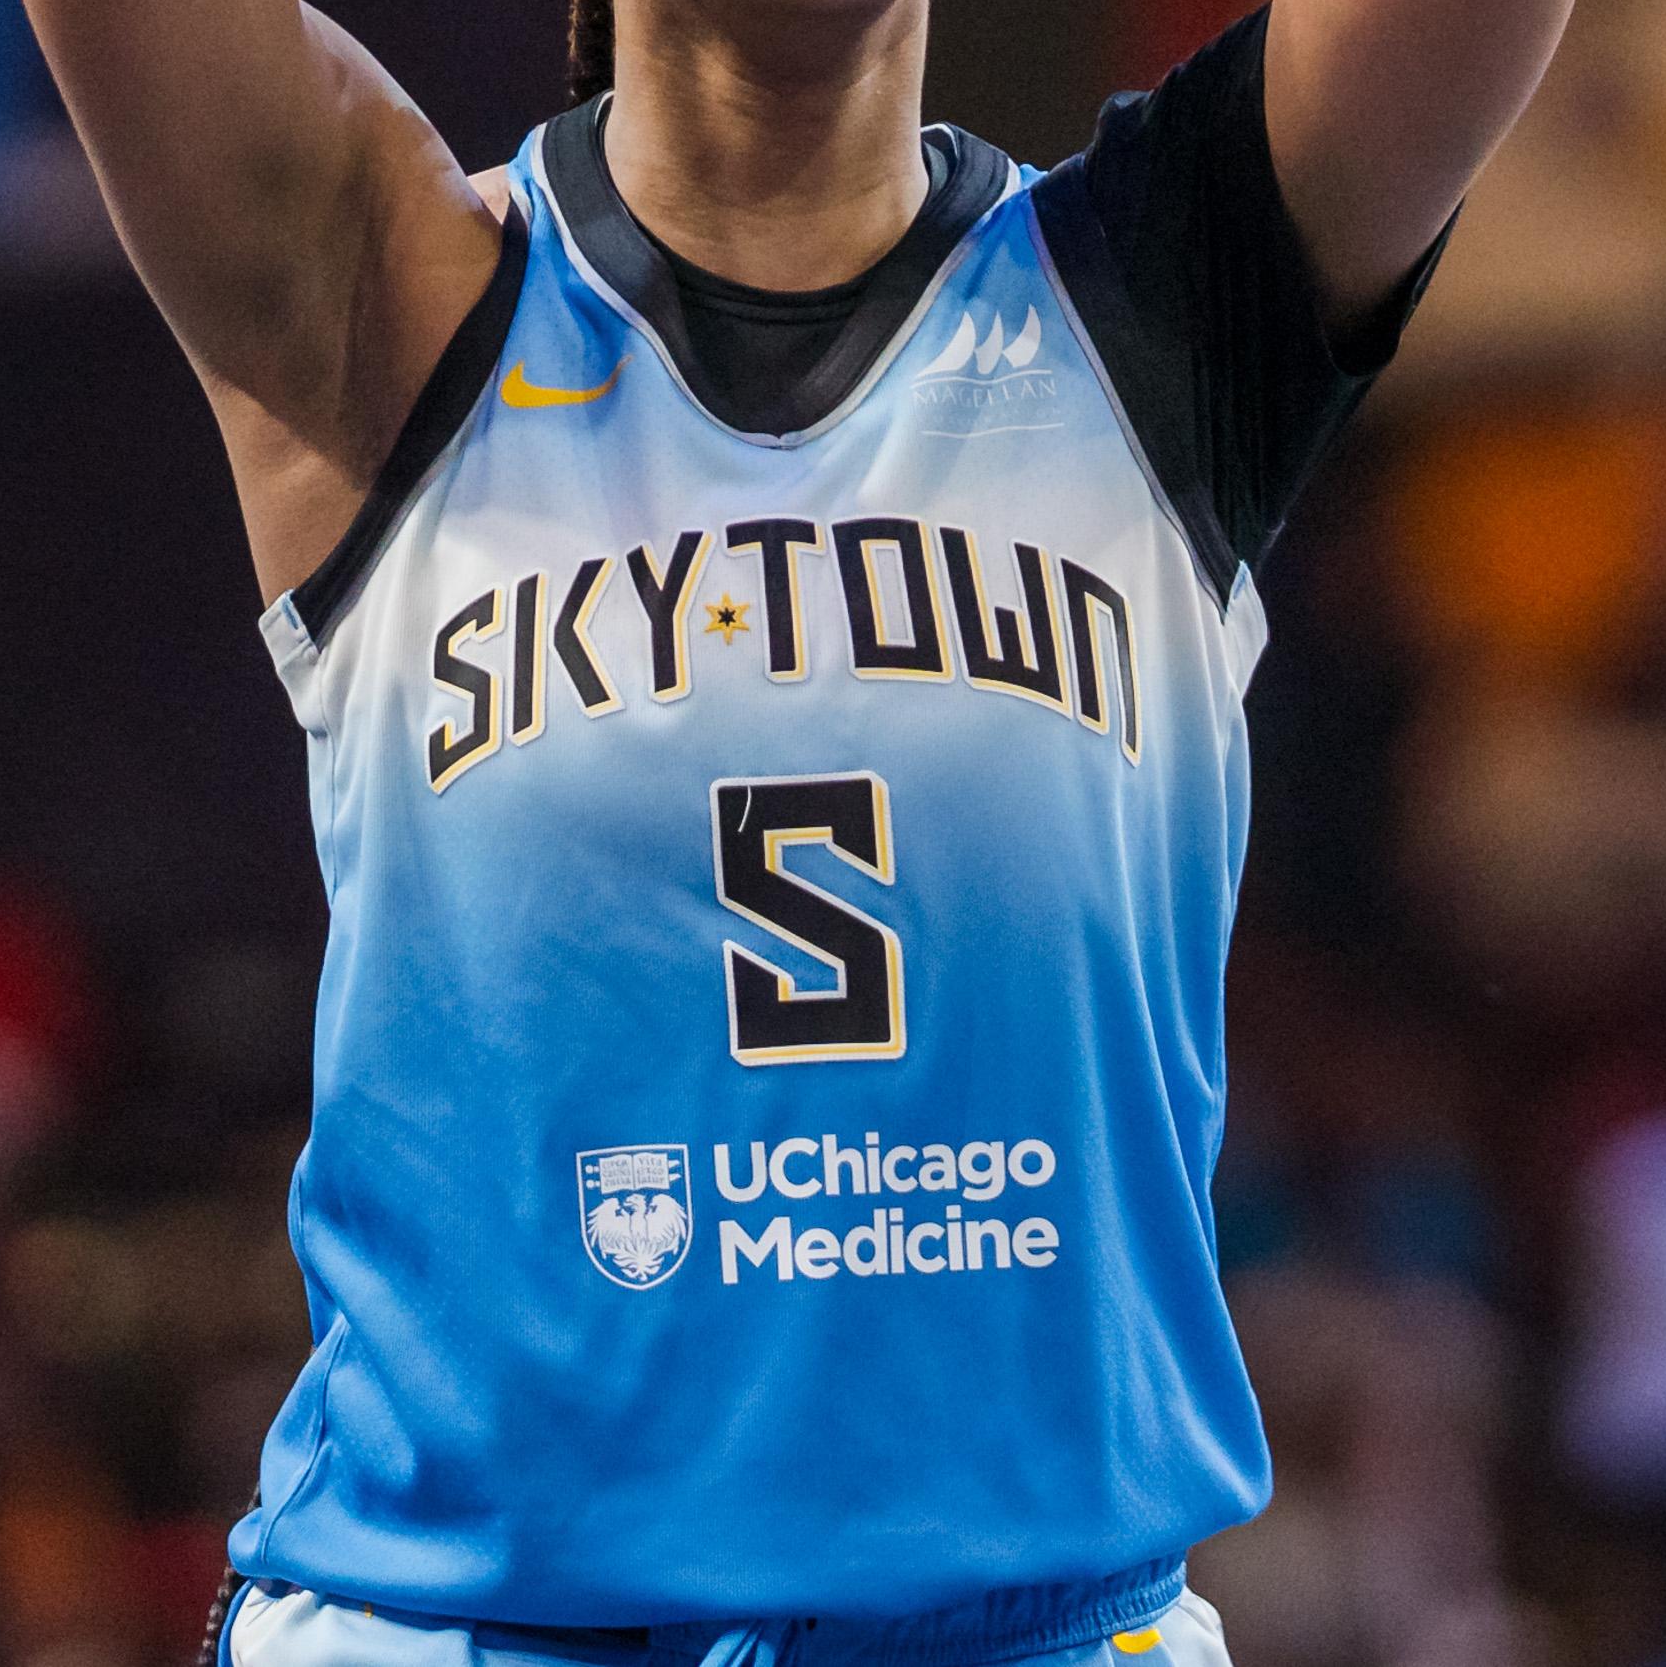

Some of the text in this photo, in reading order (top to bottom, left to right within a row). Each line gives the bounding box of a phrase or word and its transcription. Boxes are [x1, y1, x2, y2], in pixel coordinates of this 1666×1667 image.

[710, 770, 907, 1066] 5
[713, 1131, 1057, 1203] UChicago
[718, 1204, 1060, 1285] Medicine
